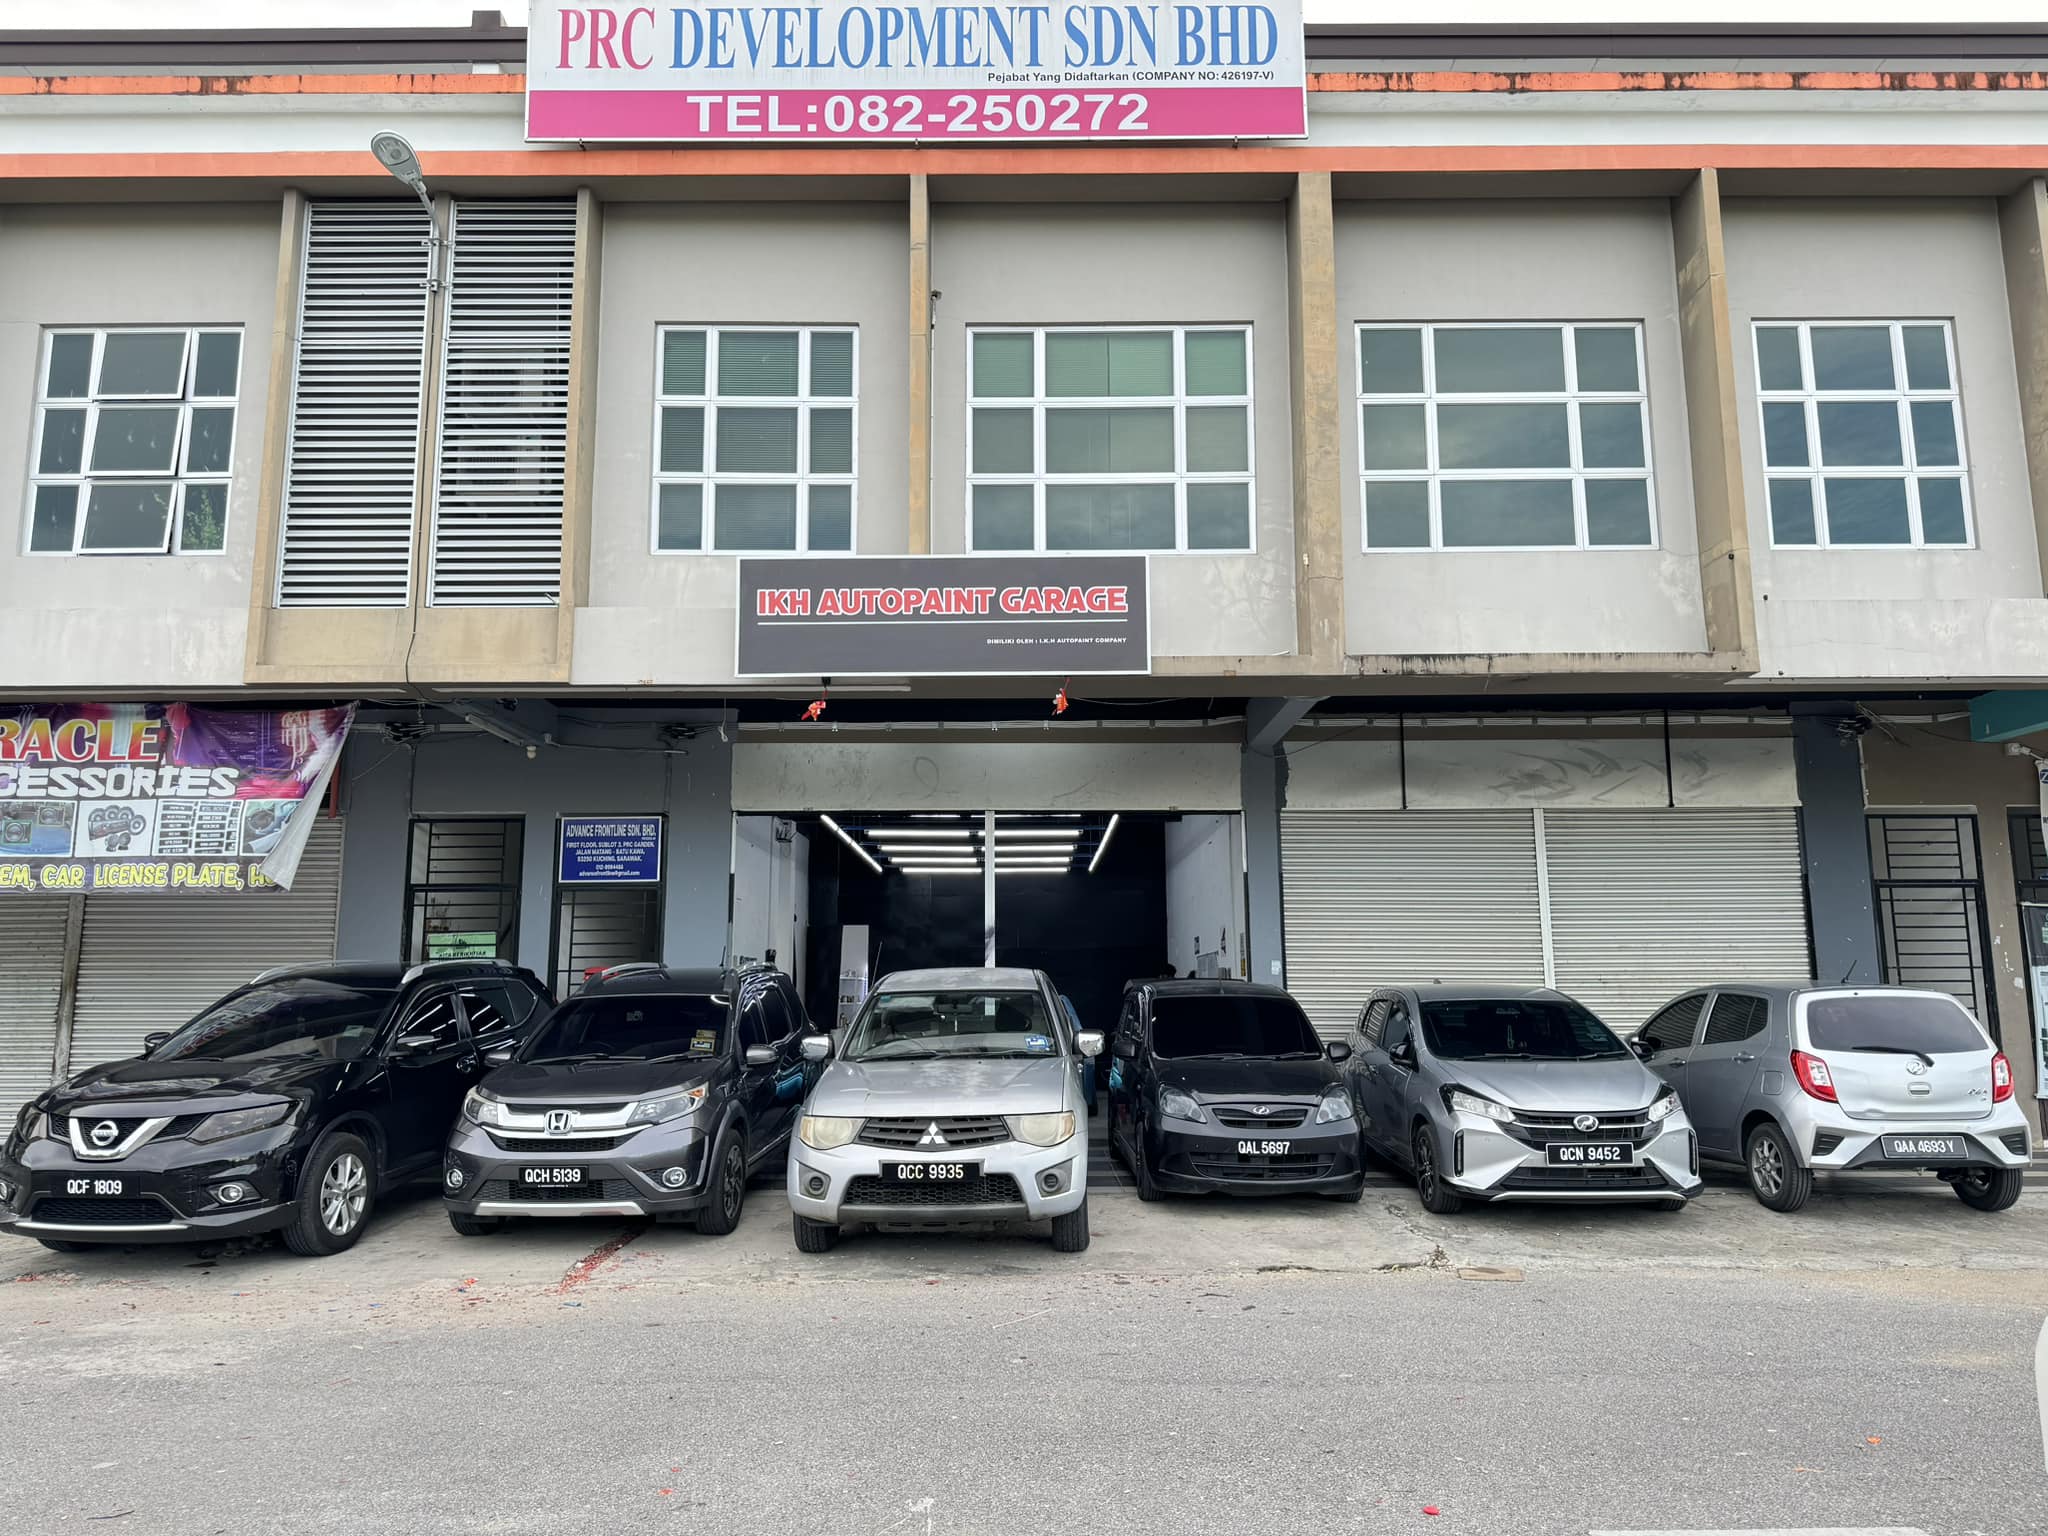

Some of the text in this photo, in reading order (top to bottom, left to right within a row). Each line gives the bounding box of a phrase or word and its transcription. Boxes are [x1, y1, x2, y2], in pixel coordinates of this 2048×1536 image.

[555, 4, 1279, 71] PRC DEVELOPMENT SDN BHD
[988, 71, 1274, 84] Pejabat Yang Didaftarkan (COMPANY NO: 426197-V)
[686, 93, 1149, 133] TEL:082-250272
[757, 586, 1128, 616] IKH AUTOPAINT GARAGE
[566, 824, 594, 837] ADVANCE
[594, 824, 627, 837] FRONTLINE
[40, 863, 86, 887] CAR
[93, 862, 168, 887] LICENSE
[171, 862, 244, 889] PLATE,
[1238, 1141, 1290, 1155] QAL 5697
[1560, 1146, 1621, 1161] QCN 9452
[1894, 1140, 1954, 1153] QAA 4693 Y
[525, 1168, 581, 1183] QCH 5139
[897, 1164, 964, 1179] QCC 9935
[67, 1179, 122, 1194] QCF 1809
